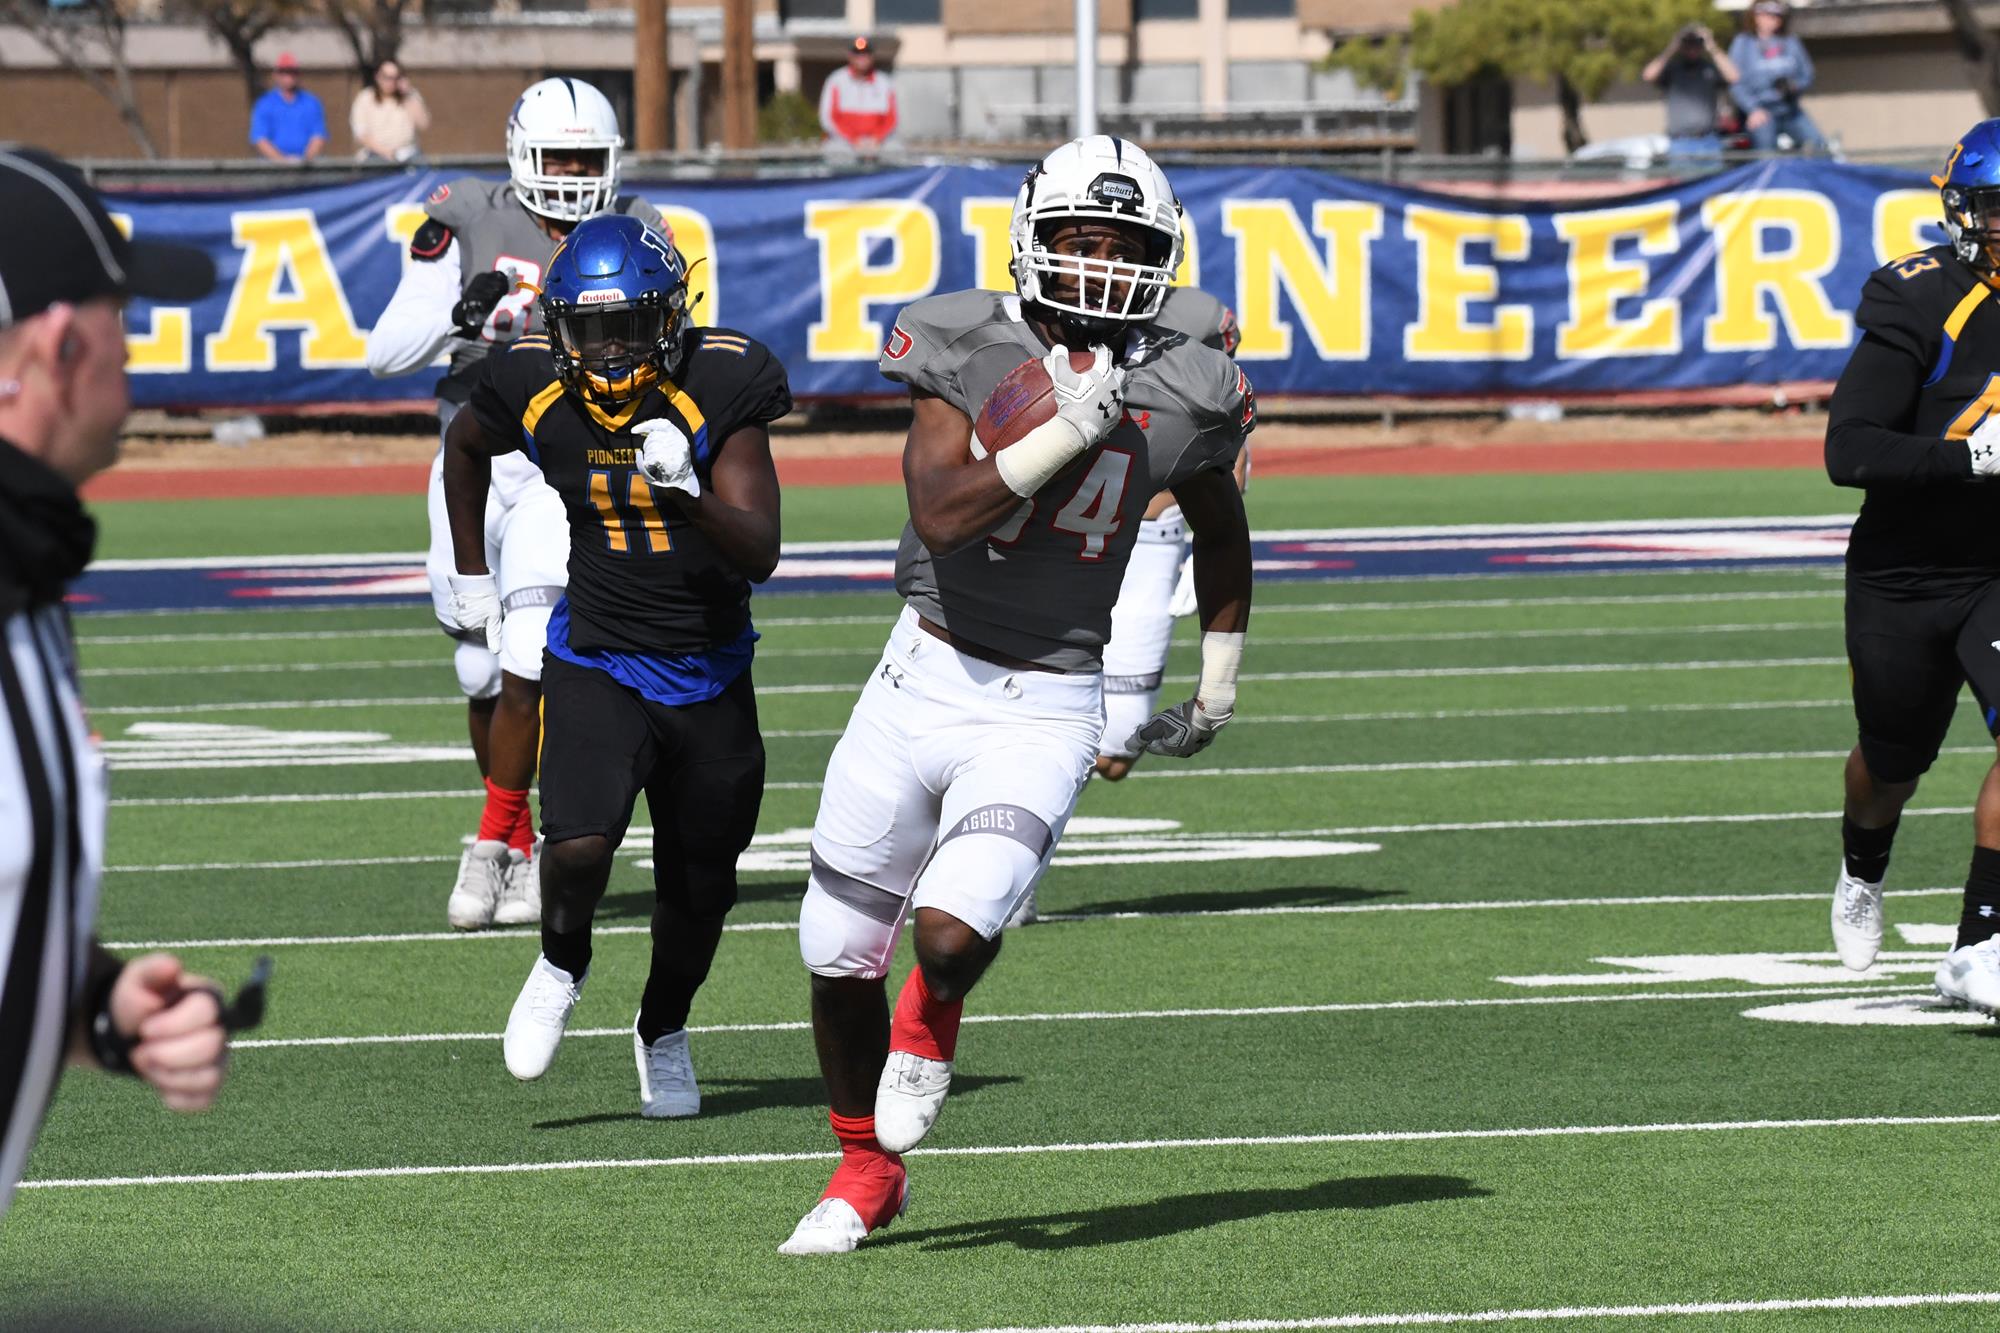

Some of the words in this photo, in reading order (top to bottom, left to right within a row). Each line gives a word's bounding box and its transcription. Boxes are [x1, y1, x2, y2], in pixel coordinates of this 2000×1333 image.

[1104, 185, 1132, 196] schutt
[804, 188, 1946, 363] PNEER
[582, 293, 620, 303] Riddell
[587, 448, 641, 465] PIONEER
[587, 469, 674, 553] 11
[509, 588, 547, 607] AGGIES
[962, 810, 1015, 832] AGGIES
